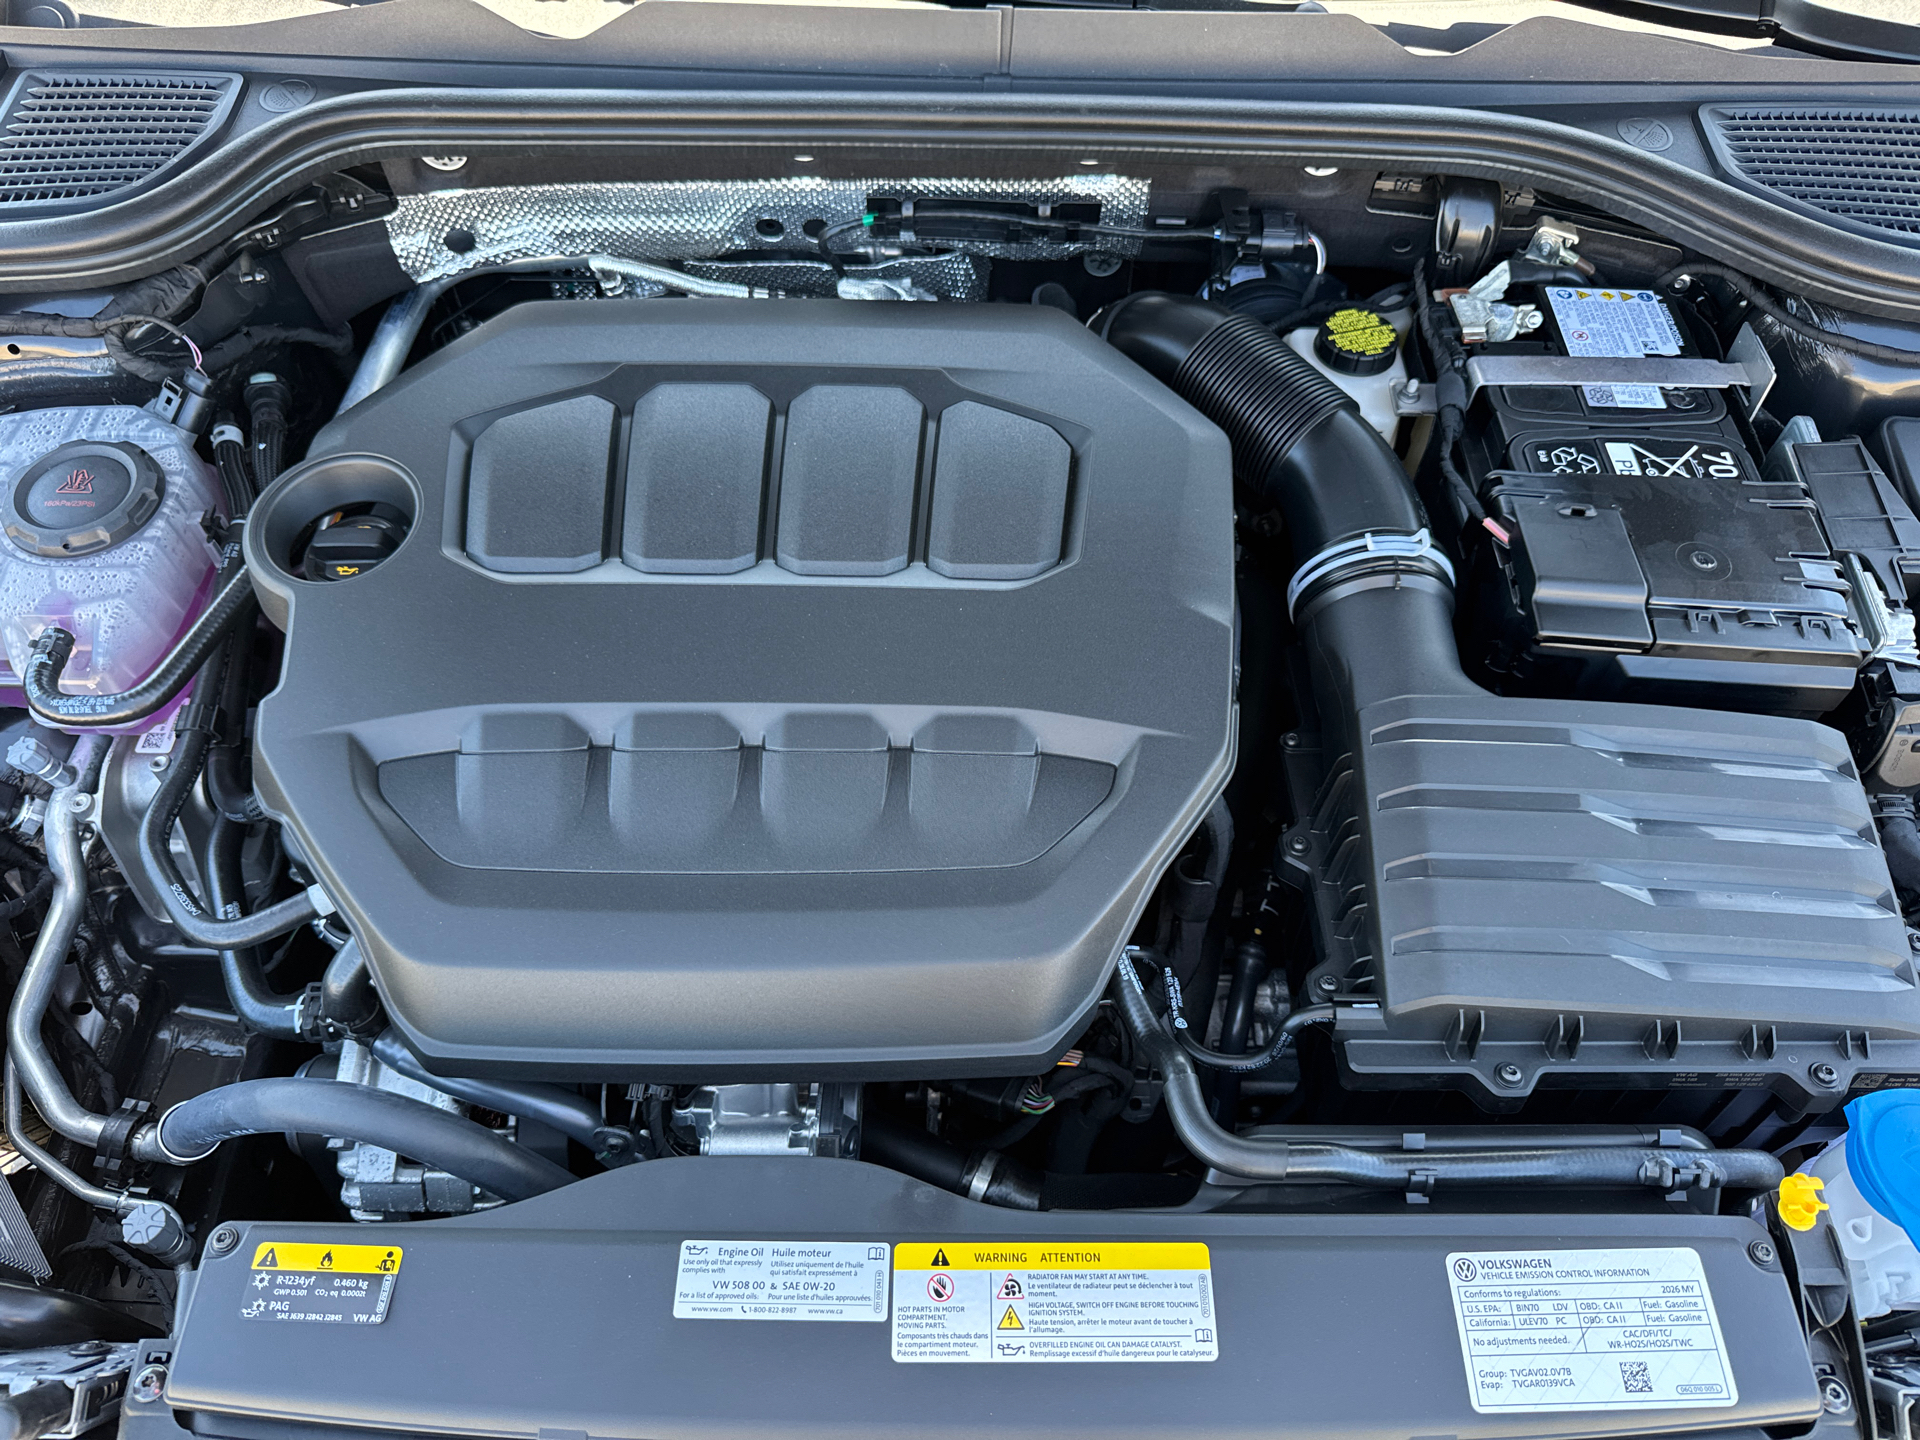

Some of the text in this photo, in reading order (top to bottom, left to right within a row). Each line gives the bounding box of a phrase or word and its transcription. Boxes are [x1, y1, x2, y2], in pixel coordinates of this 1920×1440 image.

[1702, 452, 1739, 478] 70
[718, 1247, 764, 1258] Engine Oil
[772, 1248, 796, 1256] Huile
[974, 1253, 1027, 1262] WARNING
[1040, 1253, 1100, 1262] ATTENTION
[683, 1259, 763, 1268] Use only oil that expressly
[770, 1261, 794, 1270] Utilisez
[795, 1261, 834, 1270] uniquement
[844, 1262, 864, 1270] l'huile
[1478, 1259, 1552, 1270] VOLKSWAGEN
[682, 1266, 710, 1274] complies
[808, 1269, 852, 1278] expressément
[1555, 1270, 1593, 1278] CONTROL
[1594, 1269, 1650, 1277] INFORMATION
[277, 1276, 315, 1288] R-1234yf
[334, 1279, 369, 1289] 0.460 kg
[732, 1281, 750, 1289] 508
[752, 1281, 766, 1289] 00
[782, 1282, 800, 1290] SAE
[802, 1282, 835, 1291] 0W-20
[679, 1292, 690, 1301] For
[715, 1292, 745, 1300] approved
[1463, 1288, 1561, 1299] Conforms to regulations:
[269, 1301, 290, 1311] PAG
[1516, 1304, 1540, 1312] BIN70
[1579, 1301, 1601, 1311] OBD:
[1603, 1302, 1615, 1310] CA
[1643, 1300, 1699, 1310] Fuel: Gasoline
[353, 1314, 382, 1322] VW AG
[1469, 1317, 1511, 1326] California:
[1518, 1317, 1549, 1325] ULEV70
[1582, 1315, 1604, 1326] OBD:
[1606, 1316, 1618, 1324] CA
[1646, 1314, 1703, 1324] Fuel: Gasoline
[897, 1332, 936, 1341] Composants
[1623, 1329, 1672, 1338] CAC/DFI/TC/
[905, 1341, 951, 1349] compartiment
[1486, 1337, 1537, 1348] adjustments
[1538, 1336, 1571, 1344] needed.
[1030, 1350, 1070, 1358] Remplissage
[1478, 1370, 1508, 1381] Group:
[1481, 1380, 1503, 1391] Evap:
